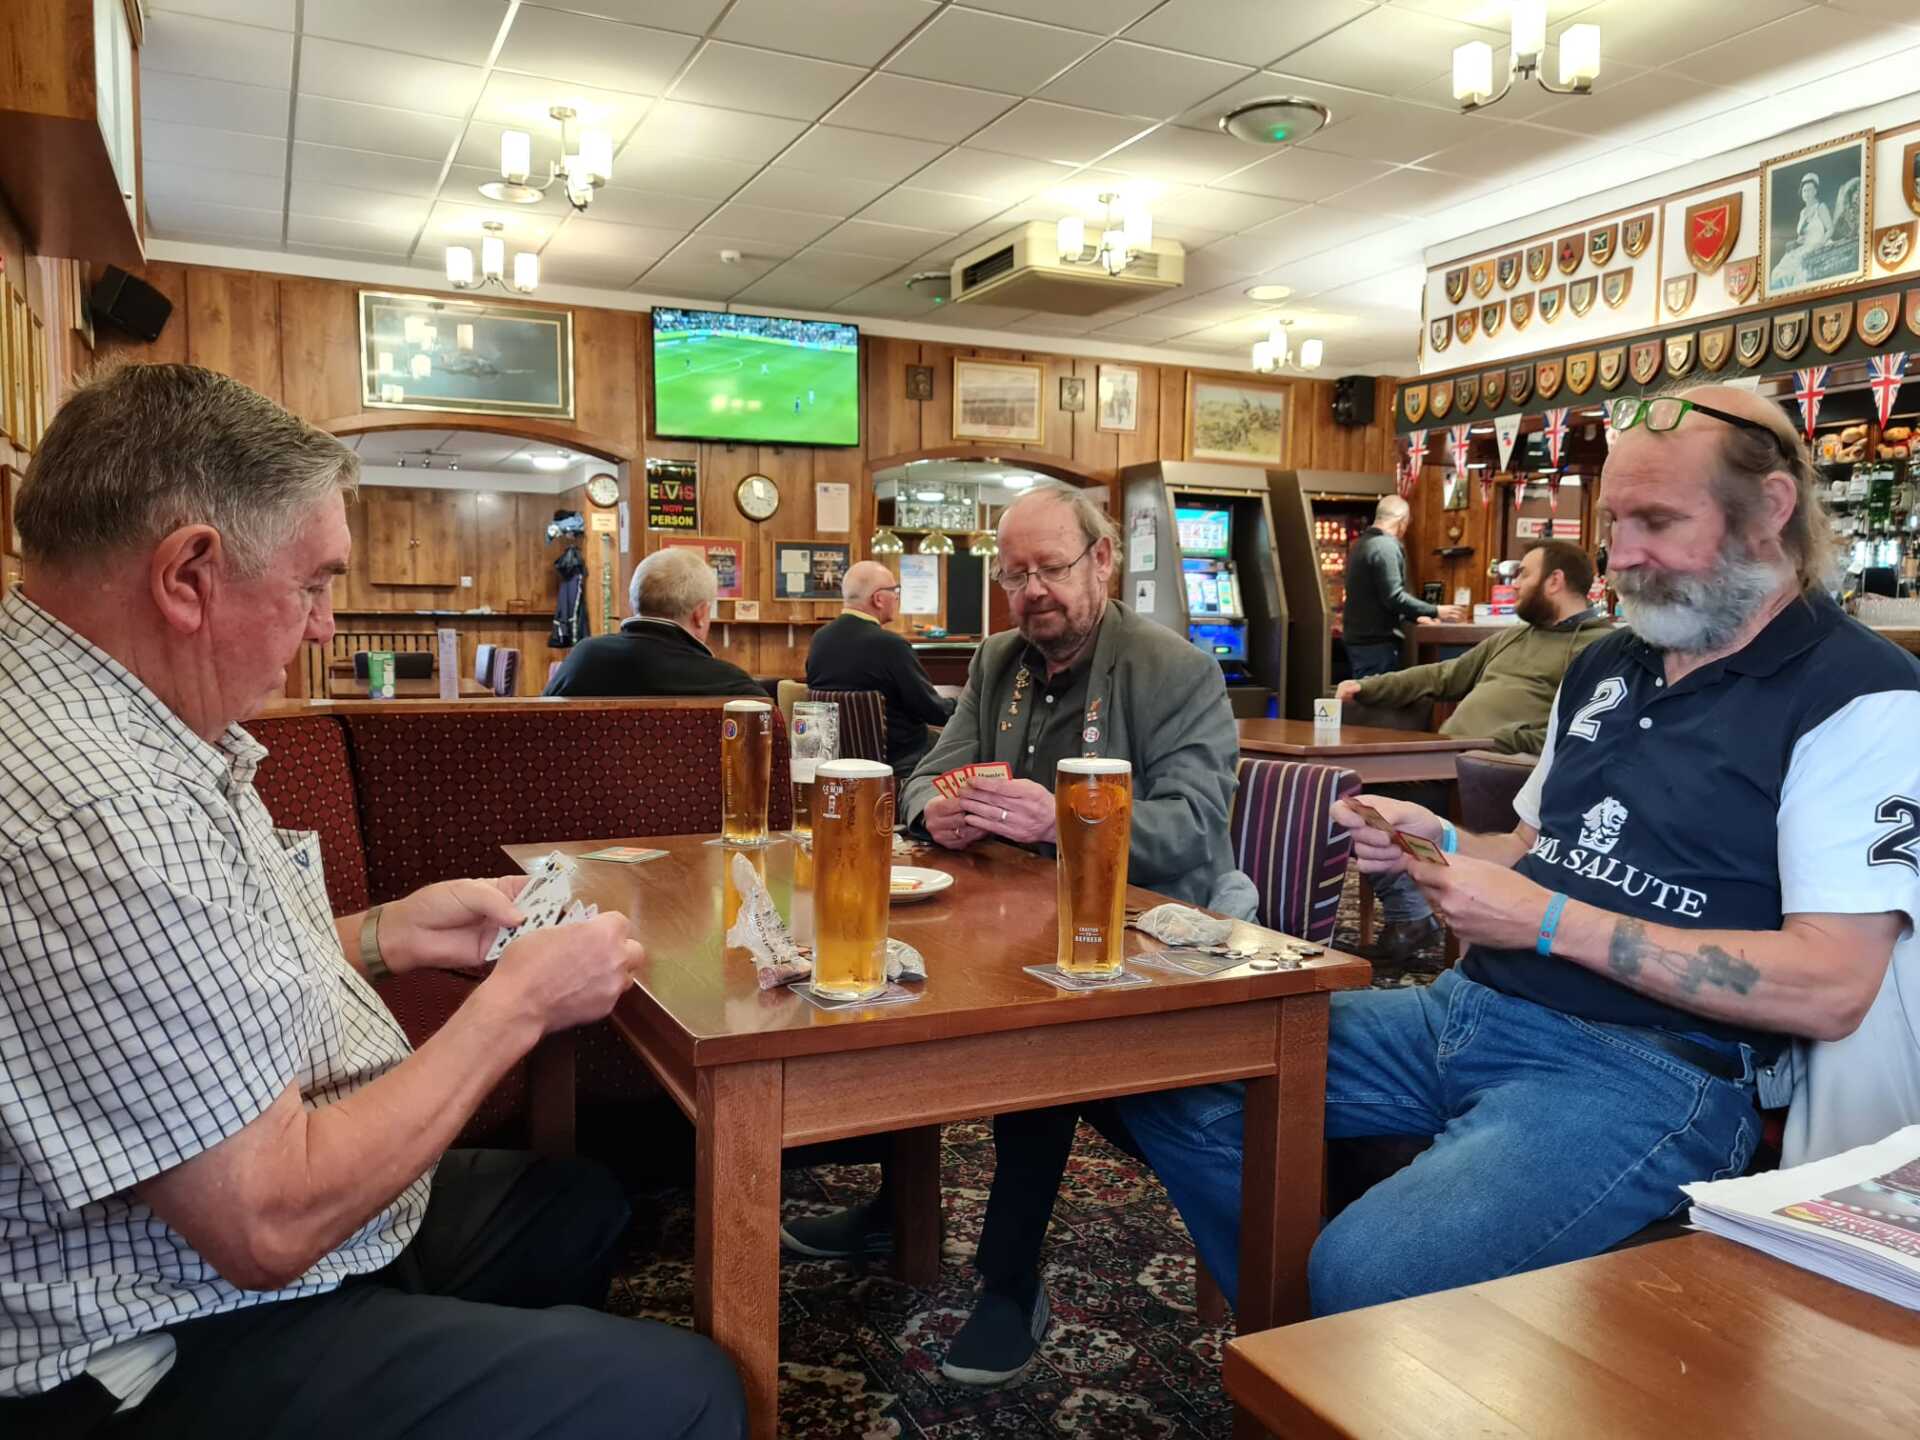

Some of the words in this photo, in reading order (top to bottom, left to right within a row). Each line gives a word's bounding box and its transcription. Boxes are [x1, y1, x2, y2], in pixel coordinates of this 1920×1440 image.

[650, 480, 695, 500] ELVIS
[650, 514, 694, 526] PERSON
[1567, 676, 1628, 742] 2
[1867, 794, 1920, 877] 2
[1562, 849, 1708, 918] SALUTE
